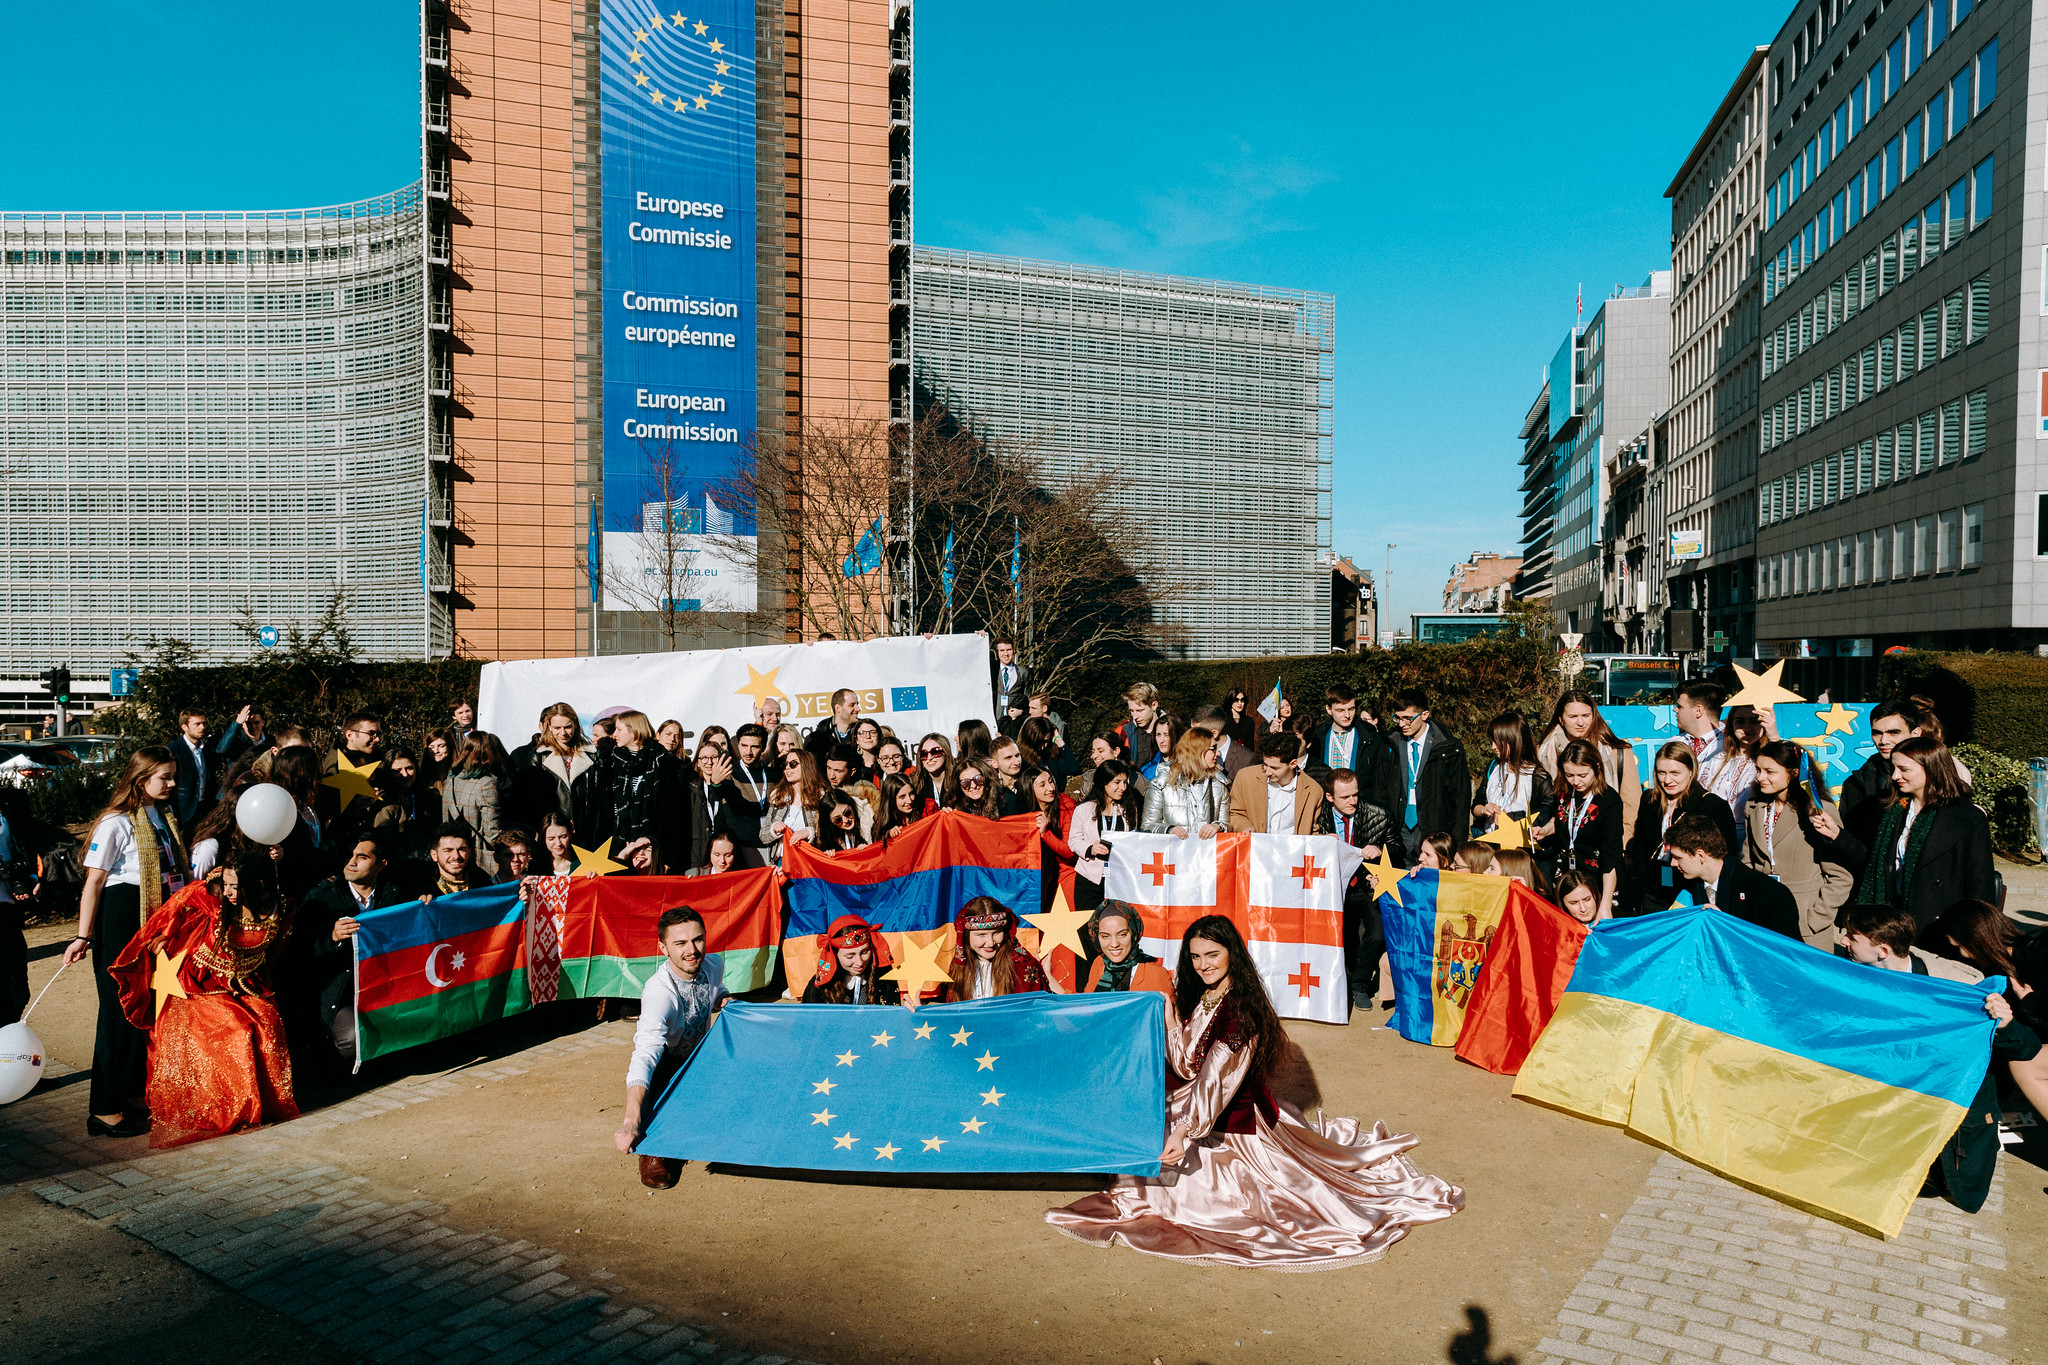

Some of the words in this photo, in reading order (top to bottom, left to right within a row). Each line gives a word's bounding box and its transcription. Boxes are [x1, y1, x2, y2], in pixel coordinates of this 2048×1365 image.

[636, 191, 724, 219] Europese
[628, 222, 732, 249] Commissie
[623, 290, 738, 318] Commission
[624, 324, 736, 348] européenne
[636, 388, 726, 414] European
[623, 418, 738, 442] Commission
[1615, 661, 1626, 669] 12
[1628, 661, 1661, 669] Brussels
[800, 691, 878, 715] YES
